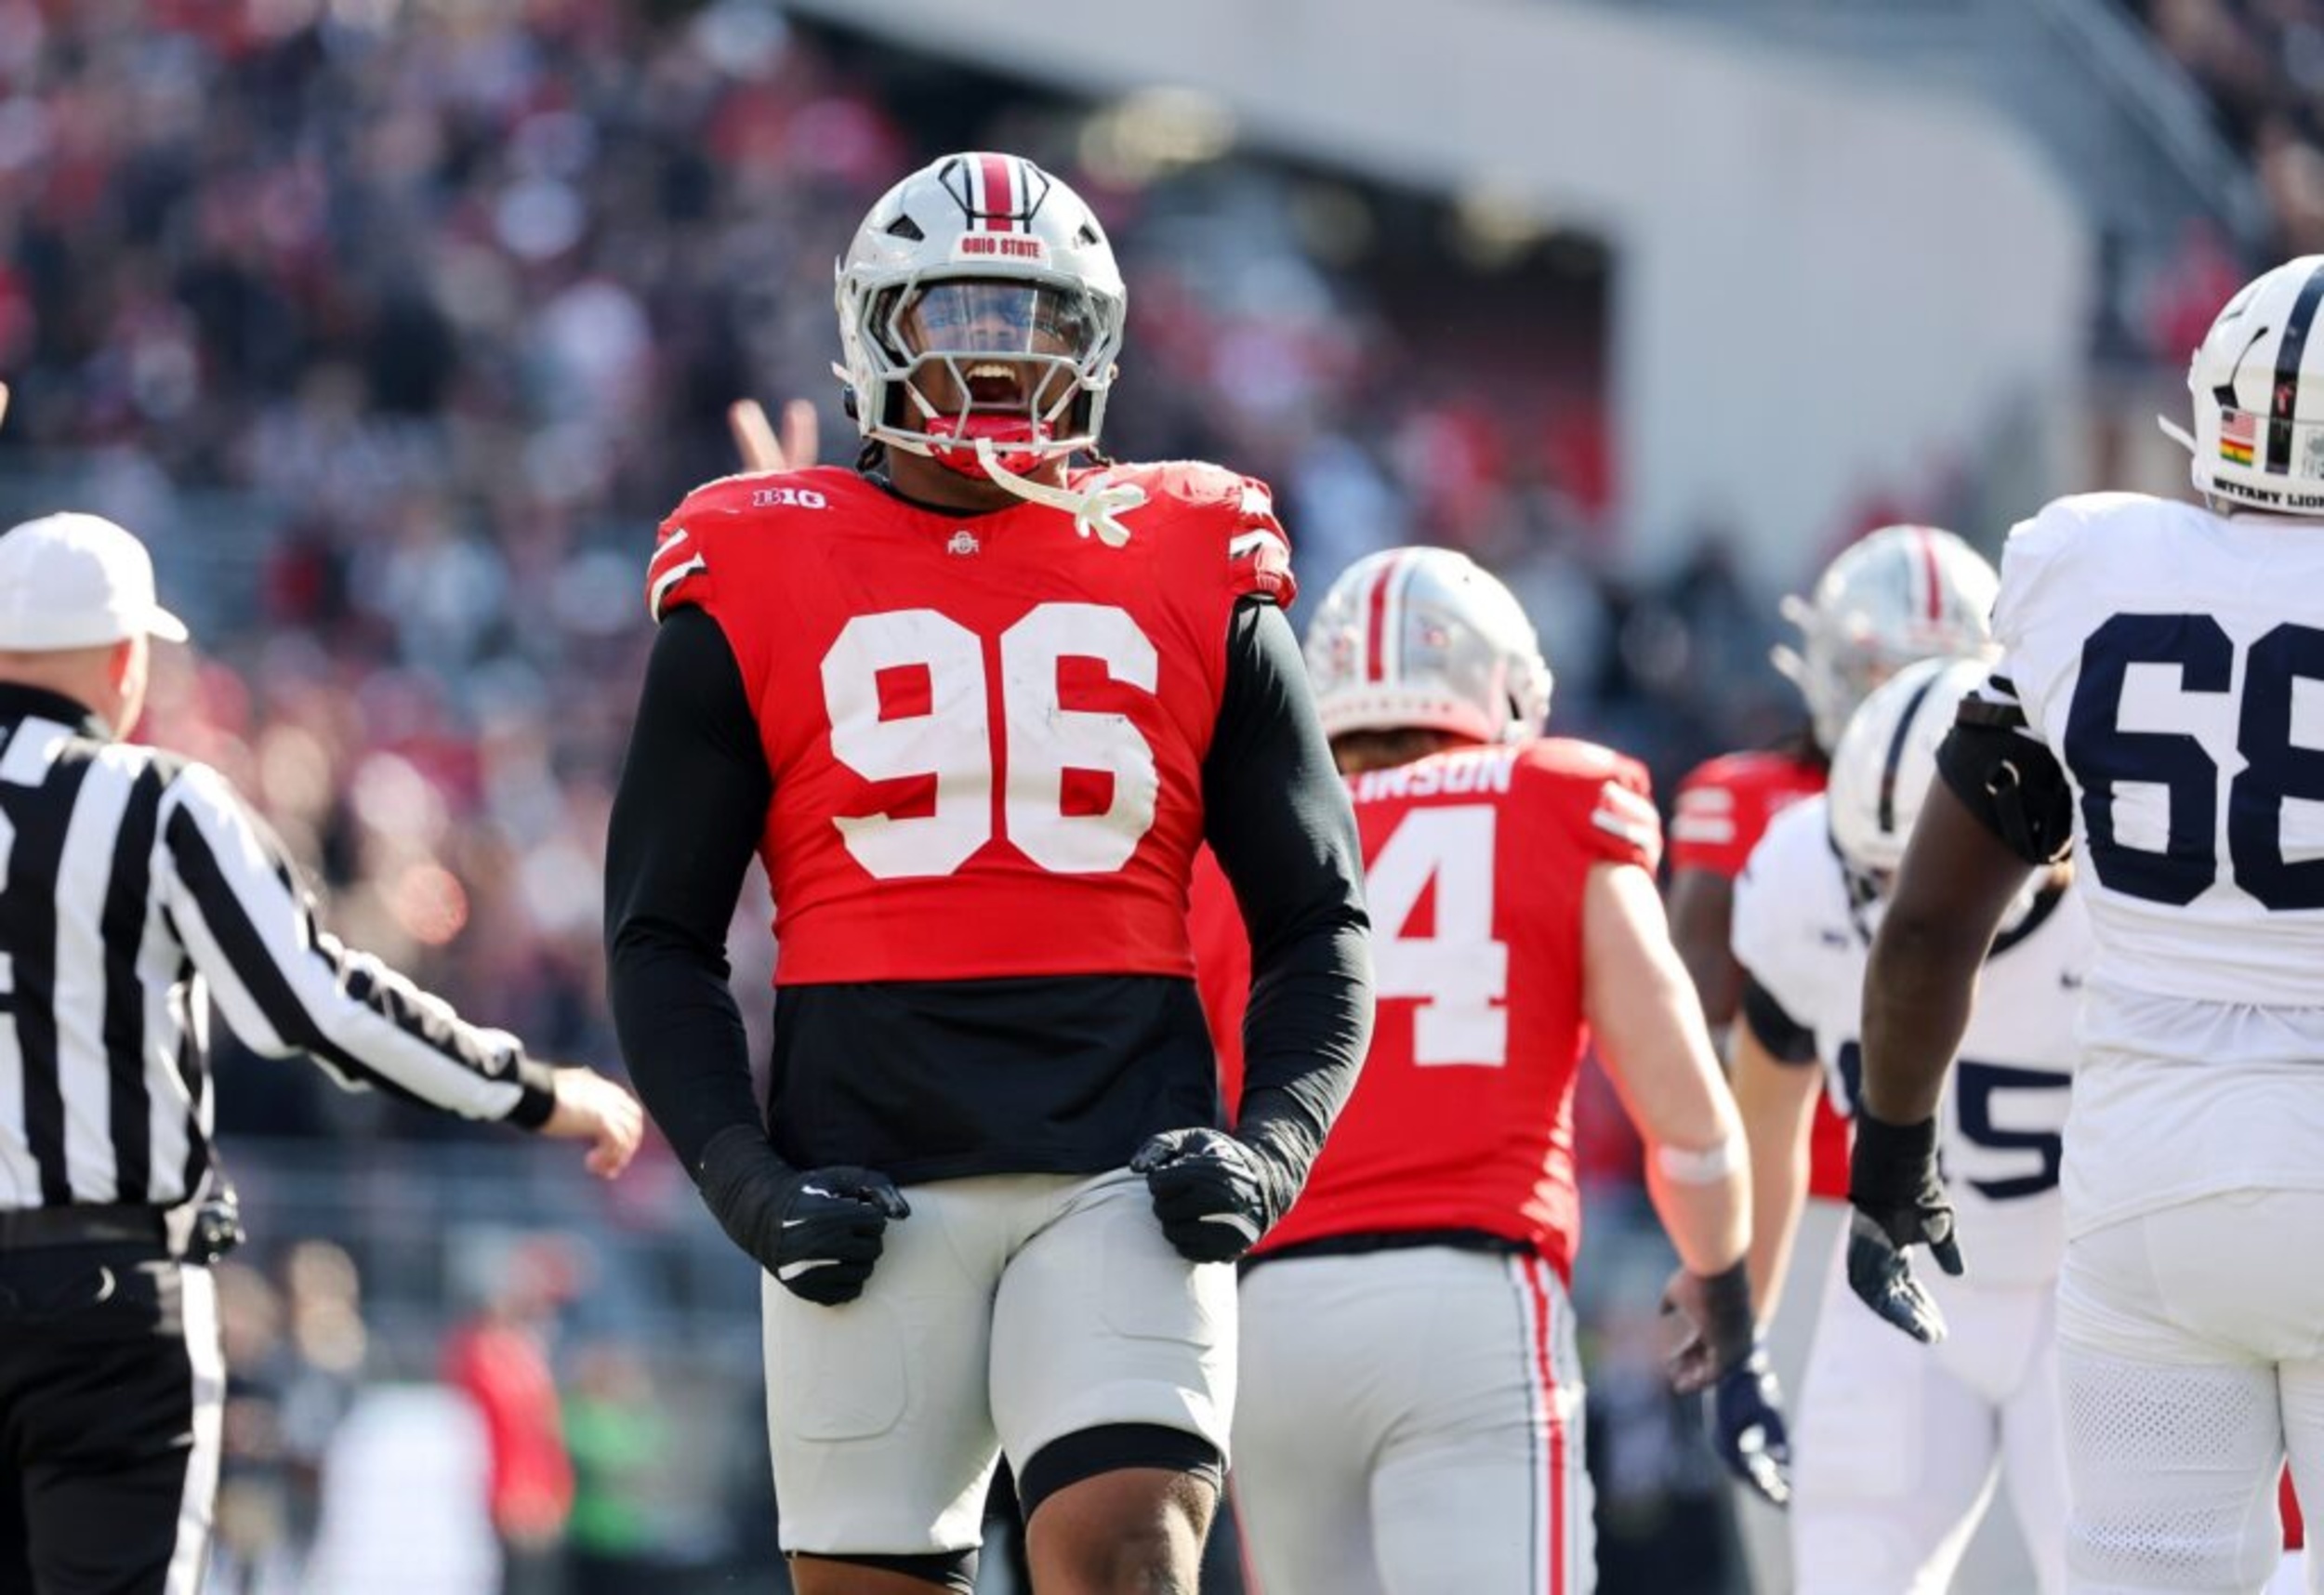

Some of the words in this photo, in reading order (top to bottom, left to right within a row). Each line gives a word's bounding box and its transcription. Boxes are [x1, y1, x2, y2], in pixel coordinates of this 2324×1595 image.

[962, 237, 996, 255] OHIO
[1000, 238, 1039, 258] STATE
[821, 602, 1159, 879] 96
[2063, 612, 2324, 912] 68
